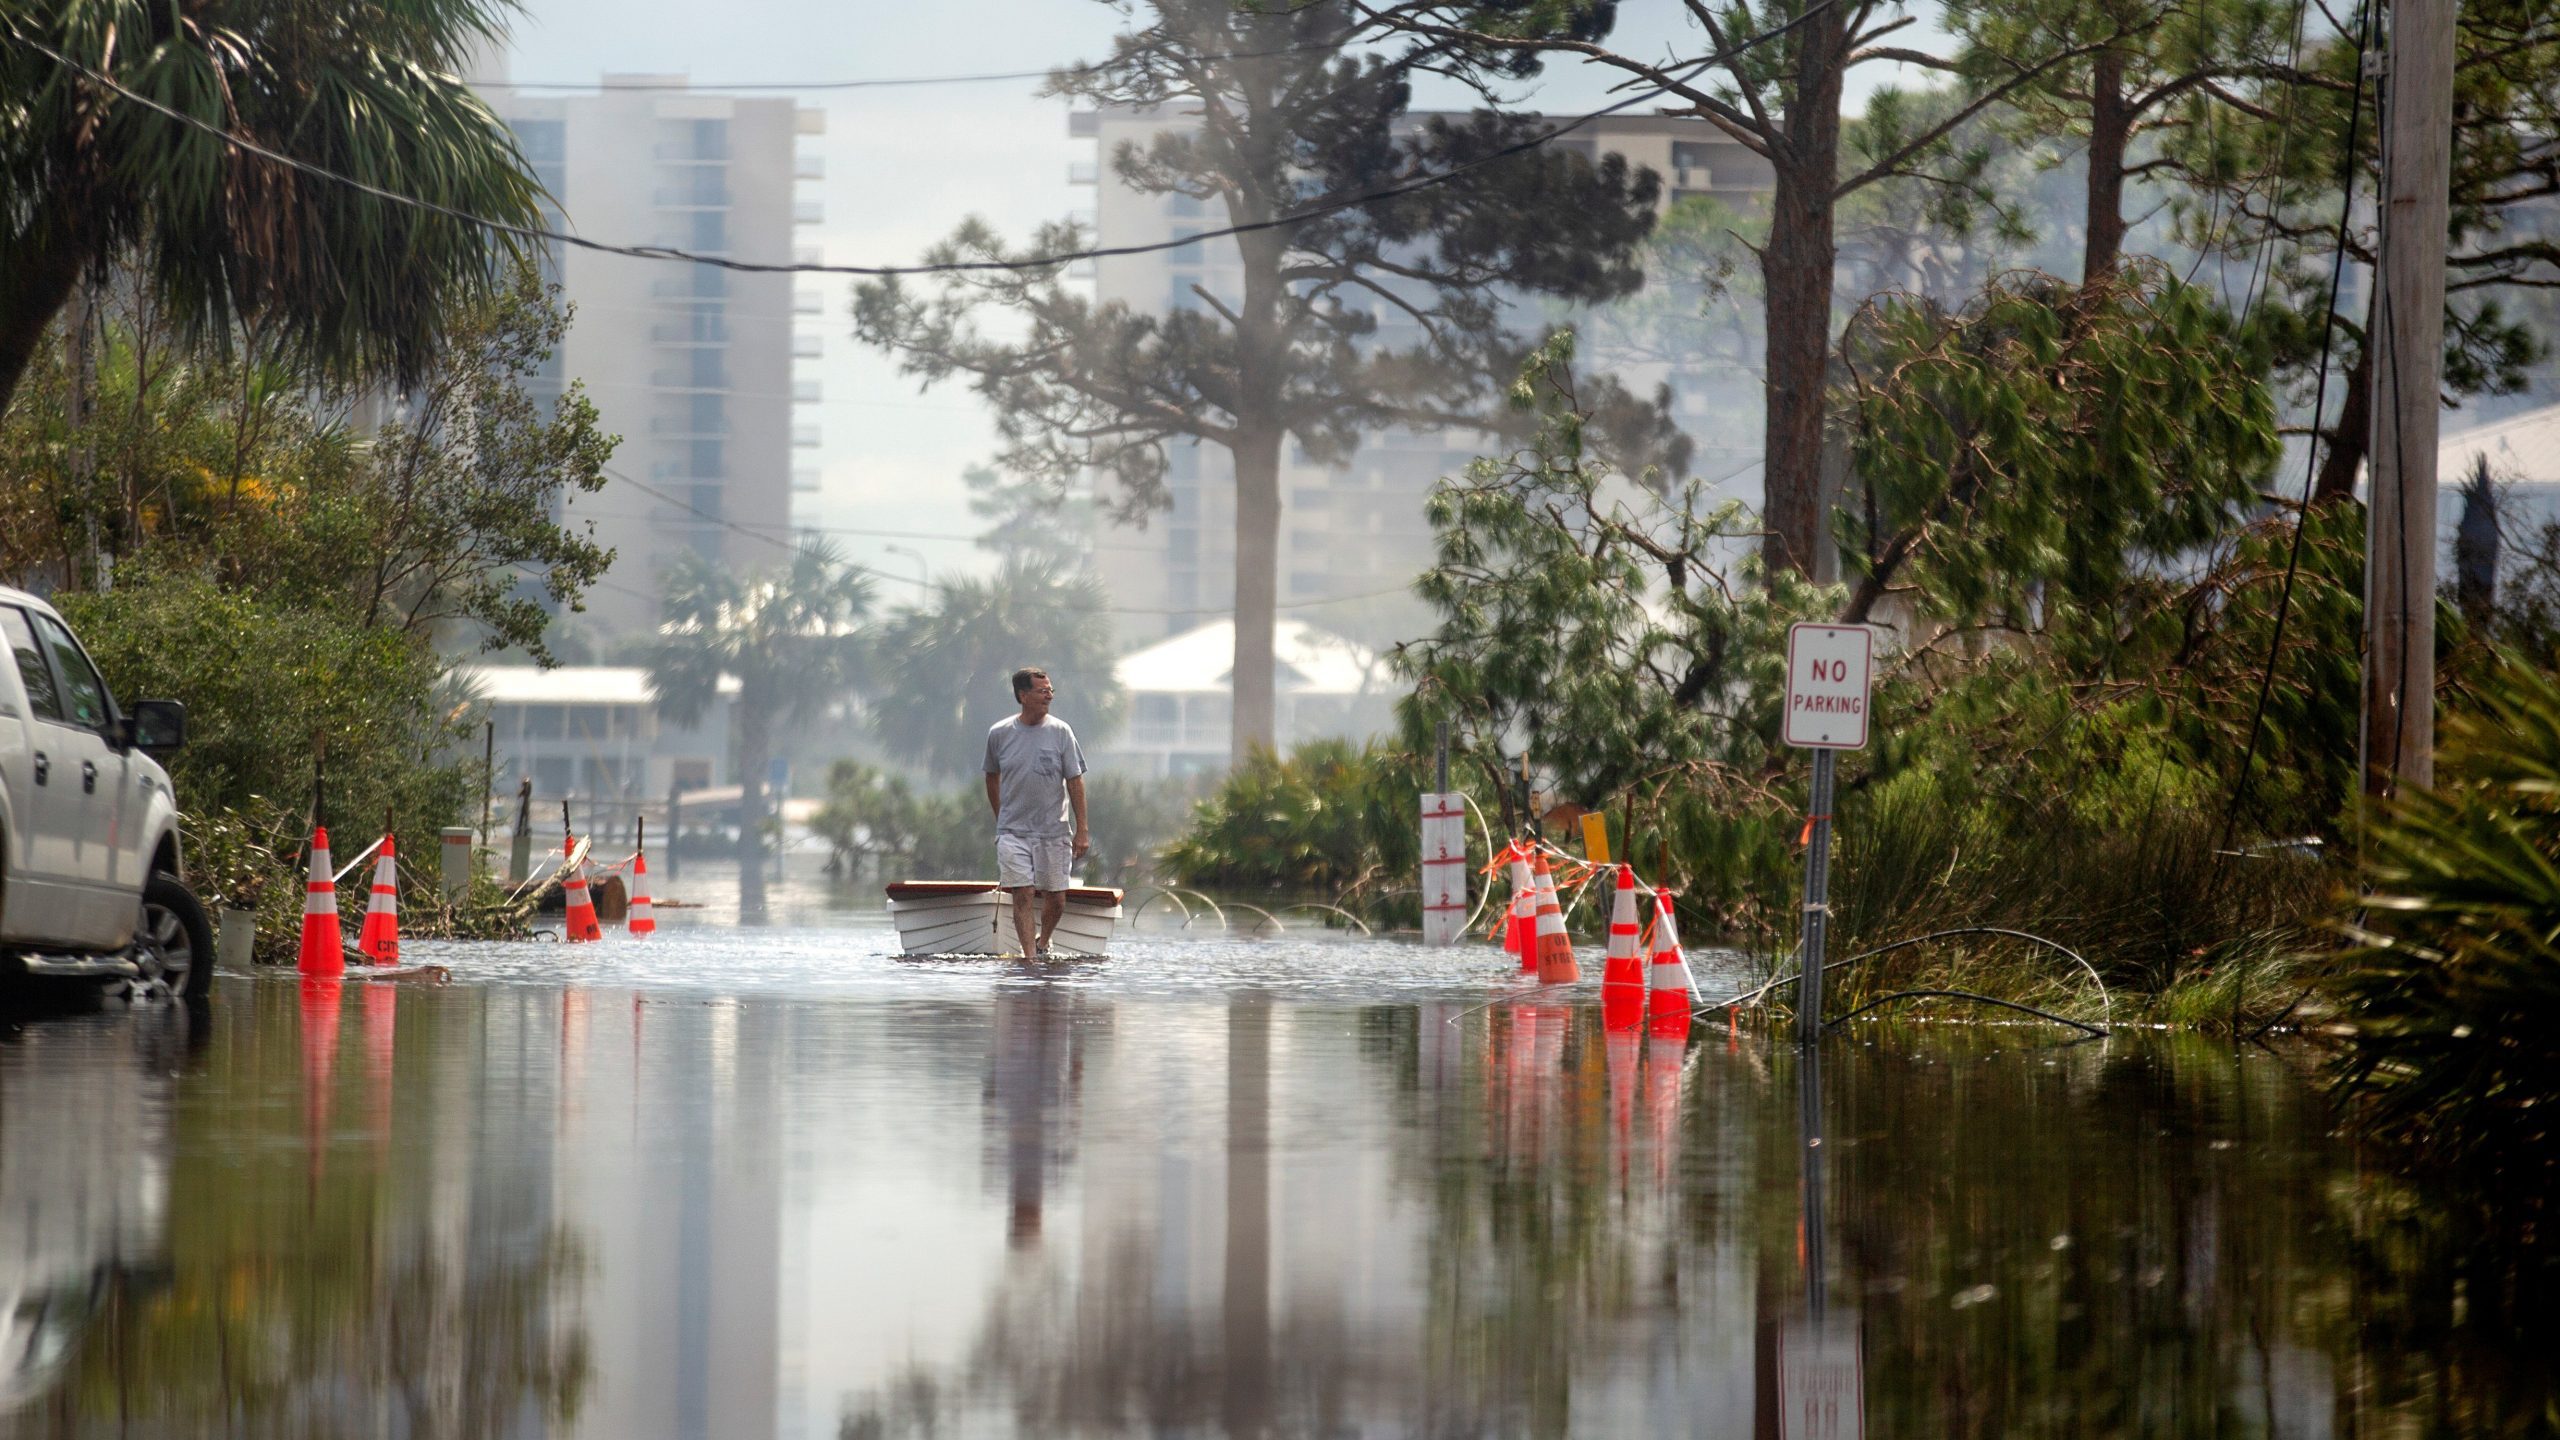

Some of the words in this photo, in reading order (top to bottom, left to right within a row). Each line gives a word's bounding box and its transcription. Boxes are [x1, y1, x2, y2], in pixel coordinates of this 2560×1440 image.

[1812, 659, 1847, 682] NO
[1794, 694, 1861, 714] PARKING
[1438, 800, 1447, 814] 4
[1439, 846, 1448, 859] 3
[1441, 893, 1450, 906] 2
[377, 940, 398, 953] CIT
